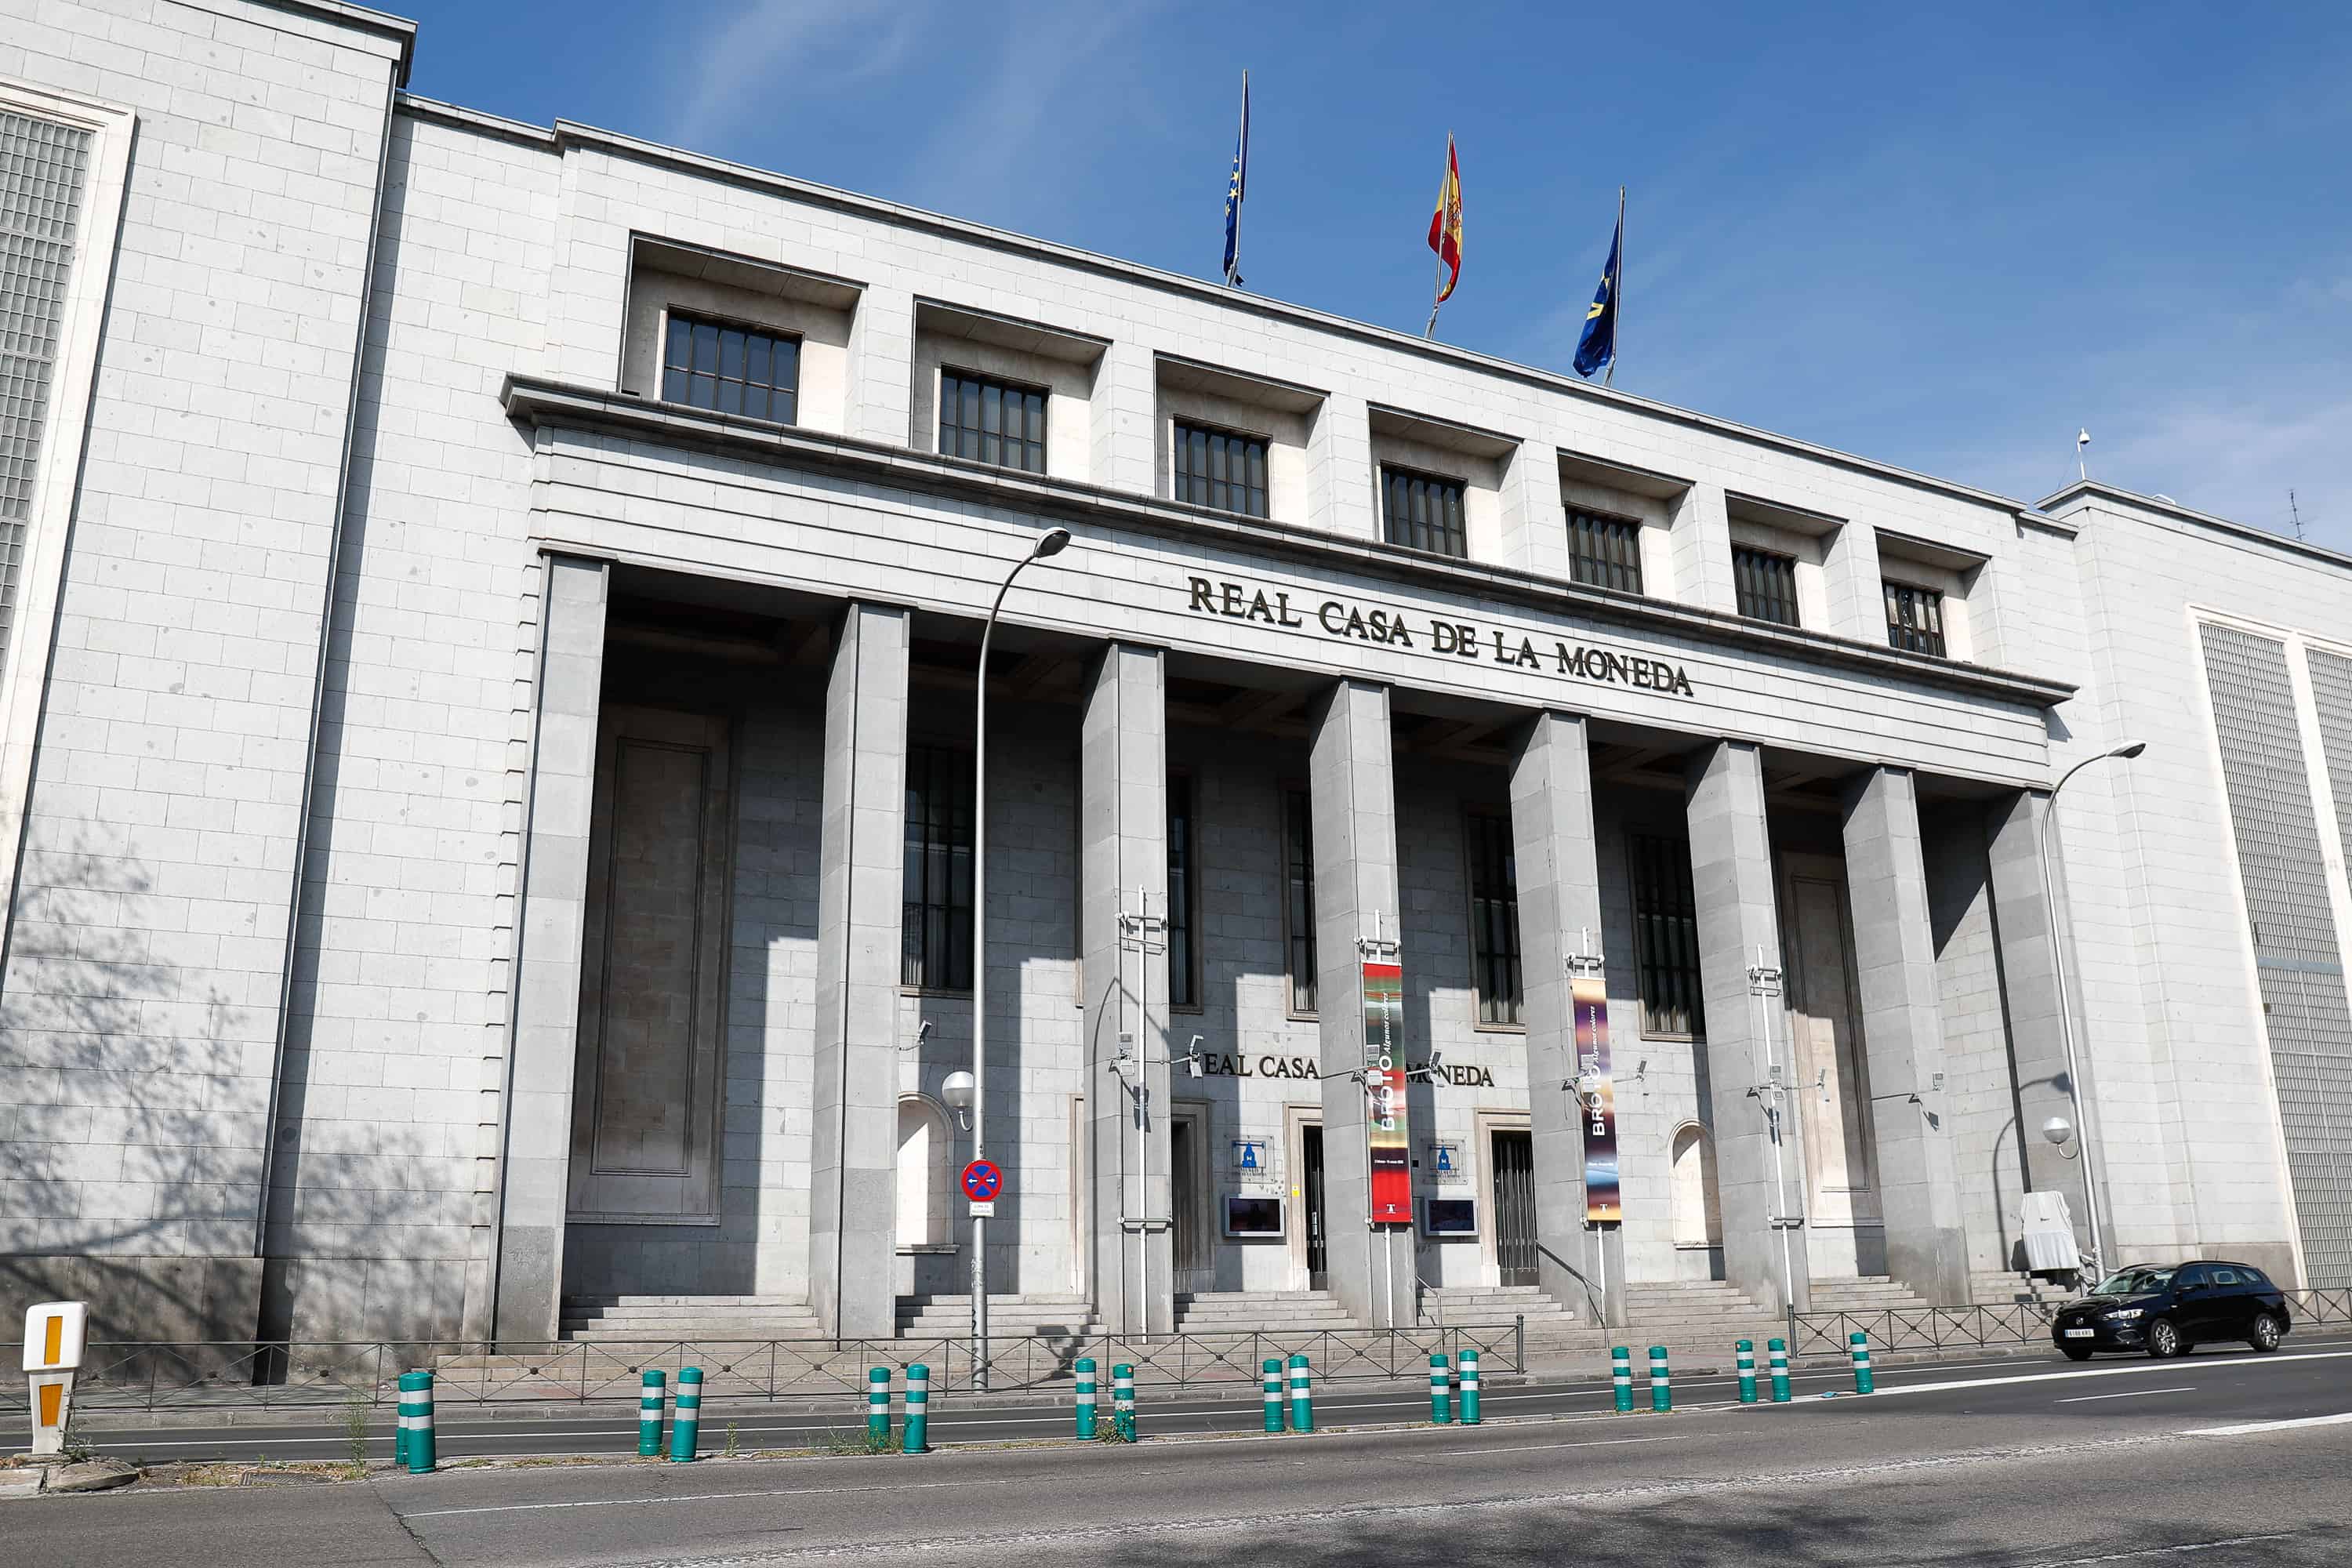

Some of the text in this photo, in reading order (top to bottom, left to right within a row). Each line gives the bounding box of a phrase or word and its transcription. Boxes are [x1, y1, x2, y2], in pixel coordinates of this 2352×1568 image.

[1188, 575, 1694, 697] REAL CASA DE LA MONEDA
[1185, 1053, 1319, 1079] EAL CASA
[1379, 1055, 1396, 1131] BROTO
[1590, 1065, 1606, 1136] BROO
